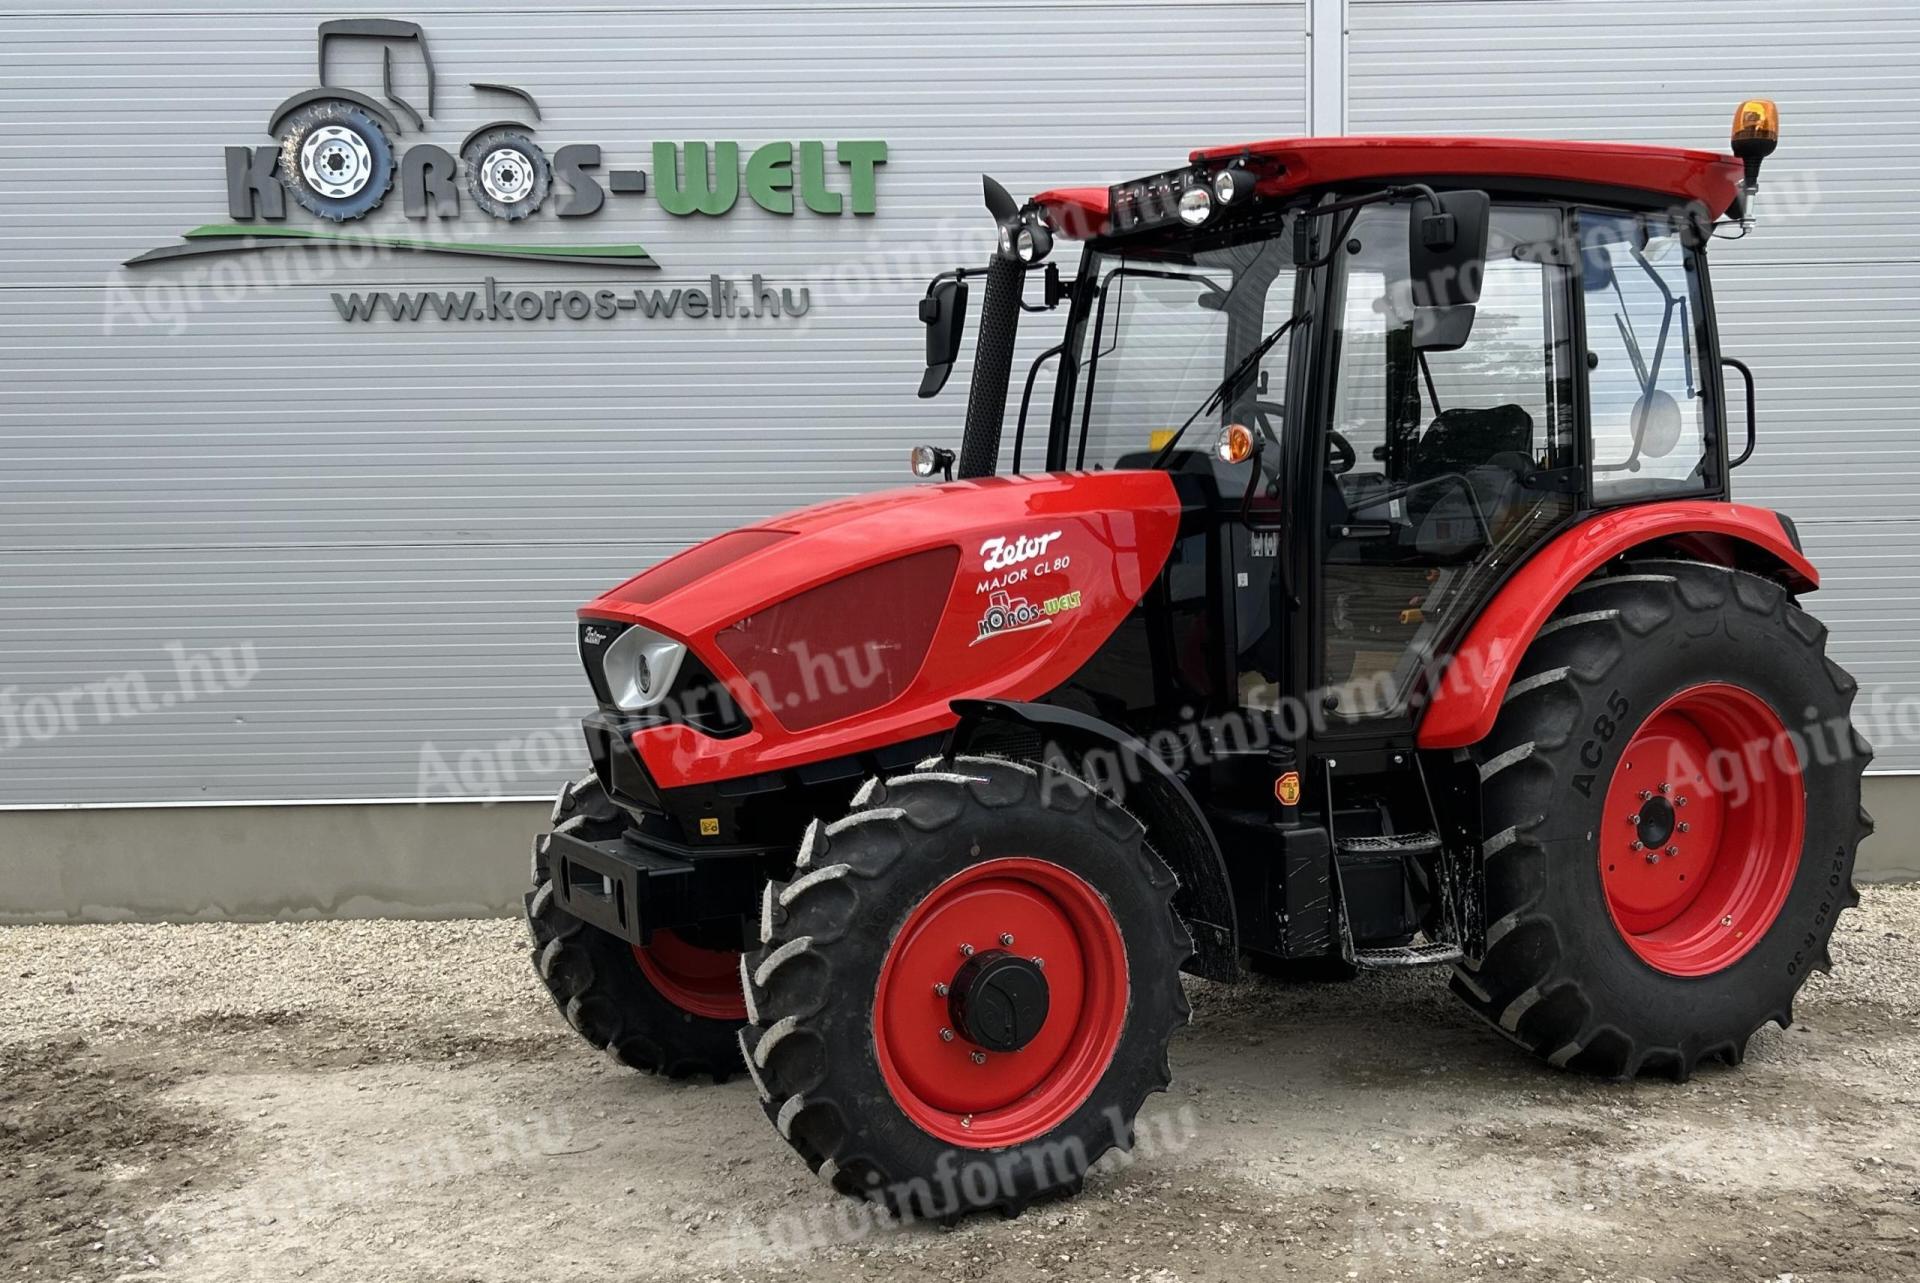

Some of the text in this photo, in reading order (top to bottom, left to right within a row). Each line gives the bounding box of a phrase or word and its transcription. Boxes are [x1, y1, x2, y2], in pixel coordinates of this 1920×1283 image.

[224, 107, 888, 223] KOROS-WELT
[331, 273, 811, 322] www.koros-welt.hu
[976, 555, 1070, 595] MAJOR CL 80
[980, 529, 1062, 572] Zetor
[1571, 688, 1630, 799] AC85
